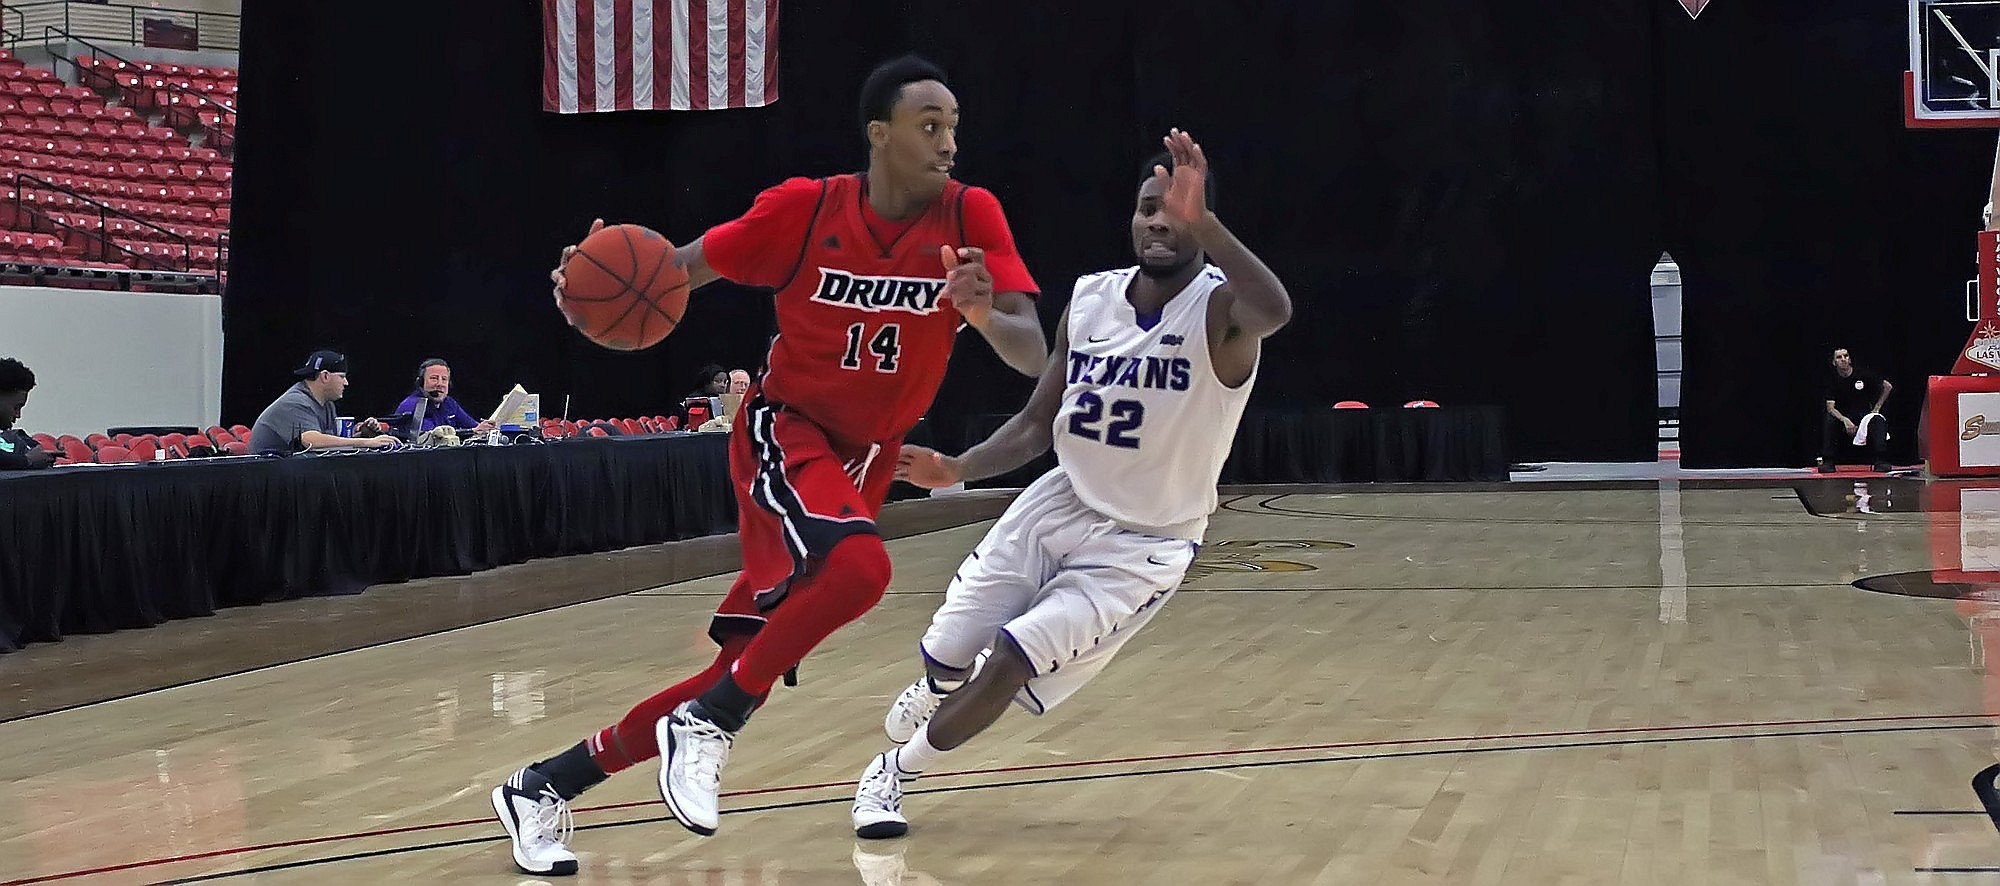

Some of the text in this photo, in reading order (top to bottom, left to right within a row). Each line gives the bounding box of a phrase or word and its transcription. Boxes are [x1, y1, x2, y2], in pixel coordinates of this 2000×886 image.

[811, 267, 947, 315] DRURY
[840, 322, 901, 374] 14
[1068, 391, 1145, 449] 22
